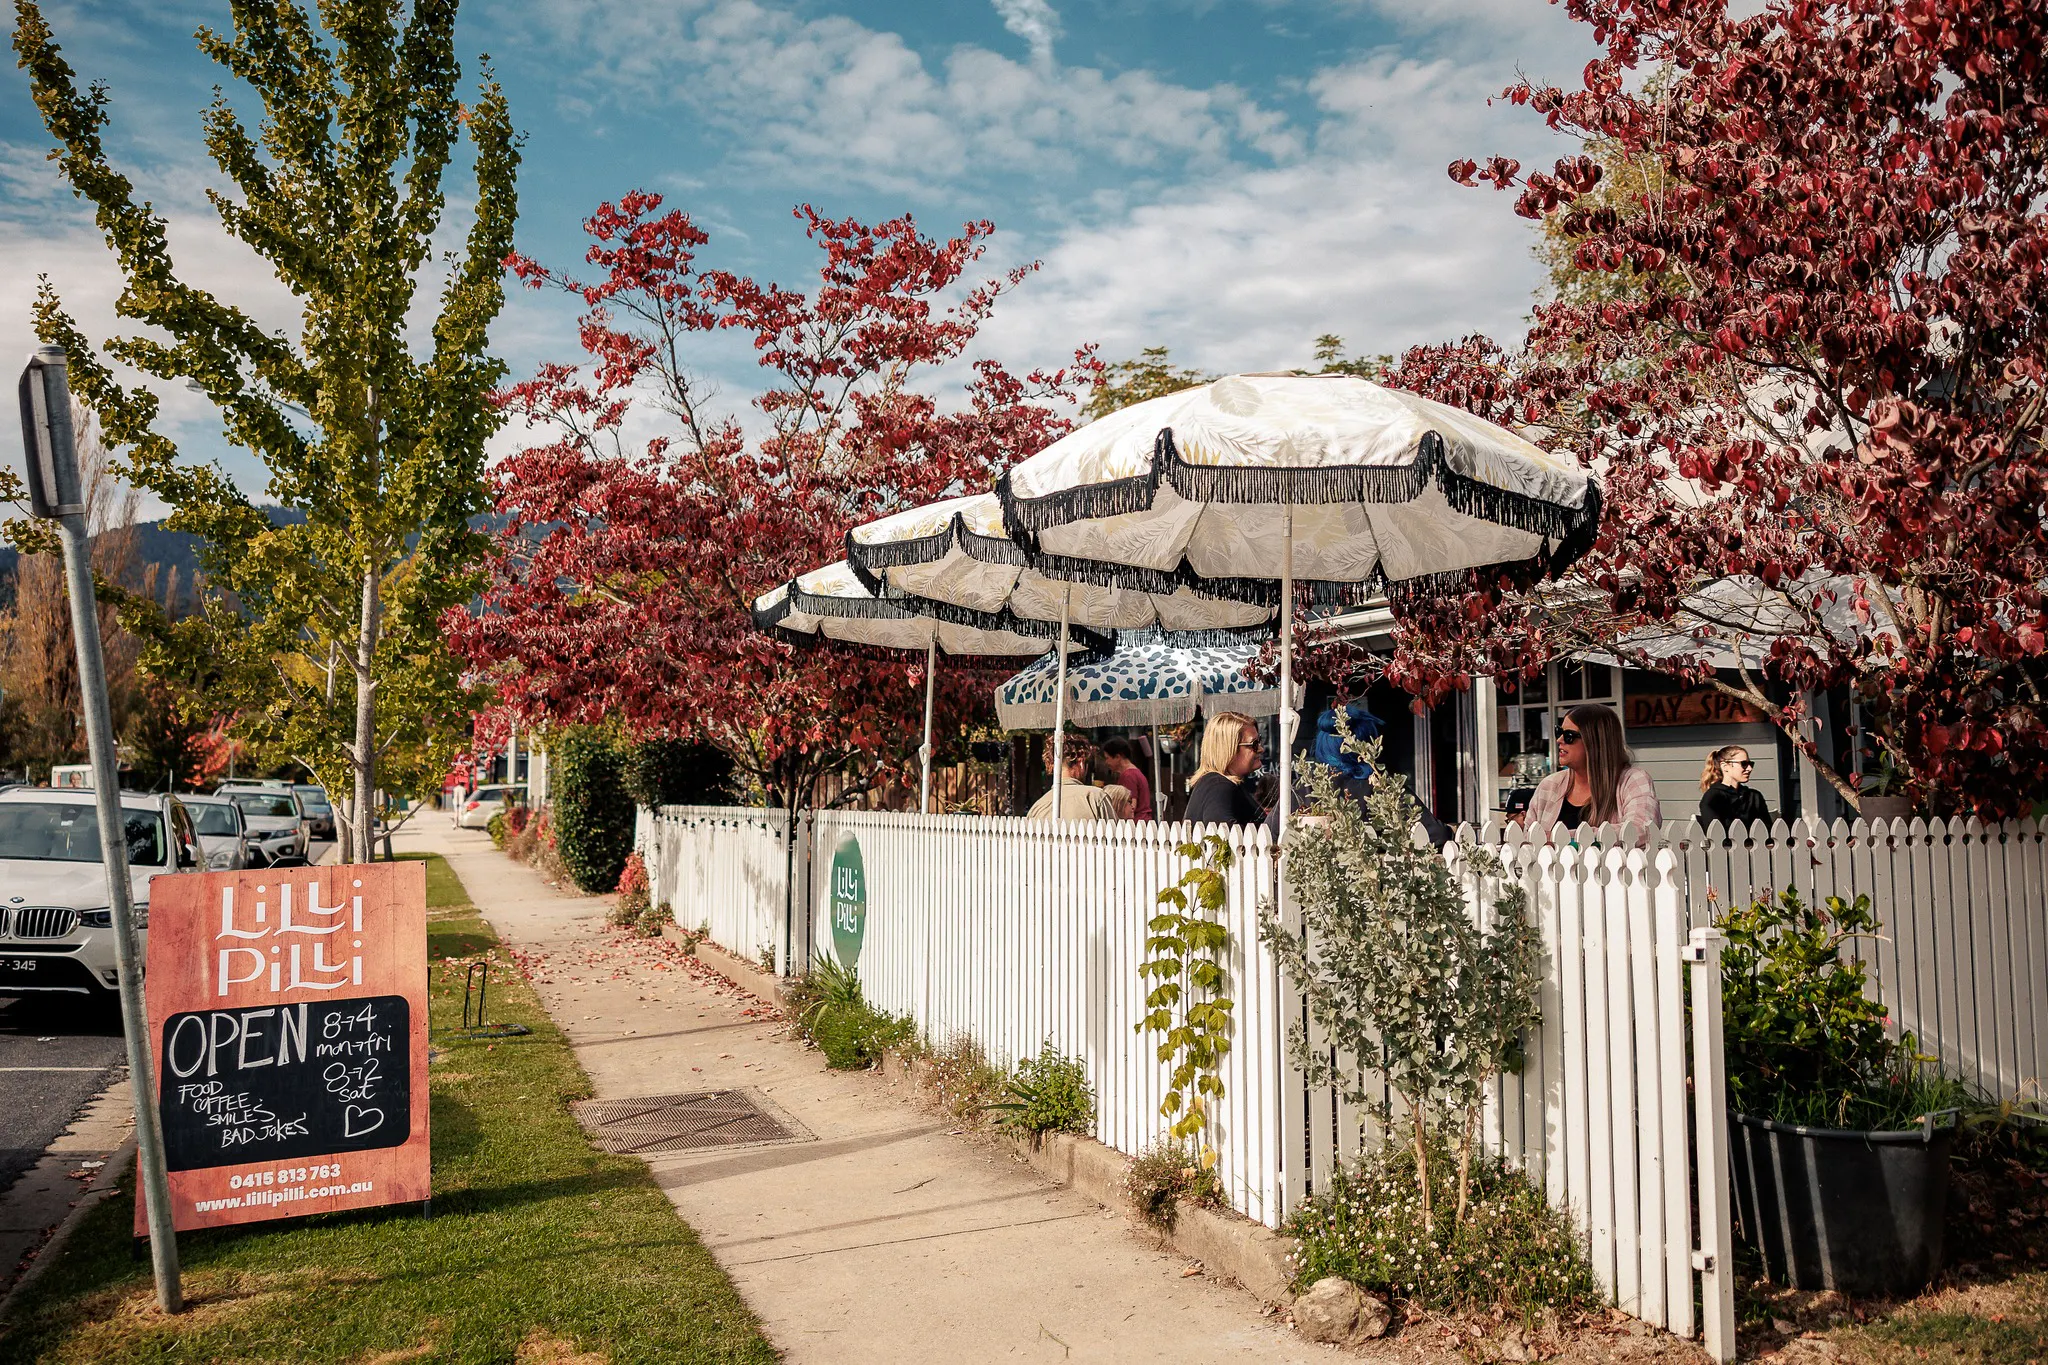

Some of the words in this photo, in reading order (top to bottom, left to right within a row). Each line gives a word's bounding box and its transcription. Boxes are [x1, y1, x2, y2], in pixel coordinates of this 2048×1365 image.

[1634, 696, 1683, 724] DAY
[1700, 693, 1747, 720] SPA
[168, 1003, 308, 1078] OPEN
[178, 1081, 223, 1104] FOOD
[193, 1092, 252, 1115] COFFEE
[206, 1100, 276, 1126] SMILES
[221, 1127, 255, 1148] BAD
[255, 1112, 309, 1142] JOKES
[229, 1171, 274, 1190] 0415
[277, 1167, 307, 1183] 813
[310, 1163, 341, 1180] 763
[195, 1180, 373, 1213] www.lillipilli.com.au
